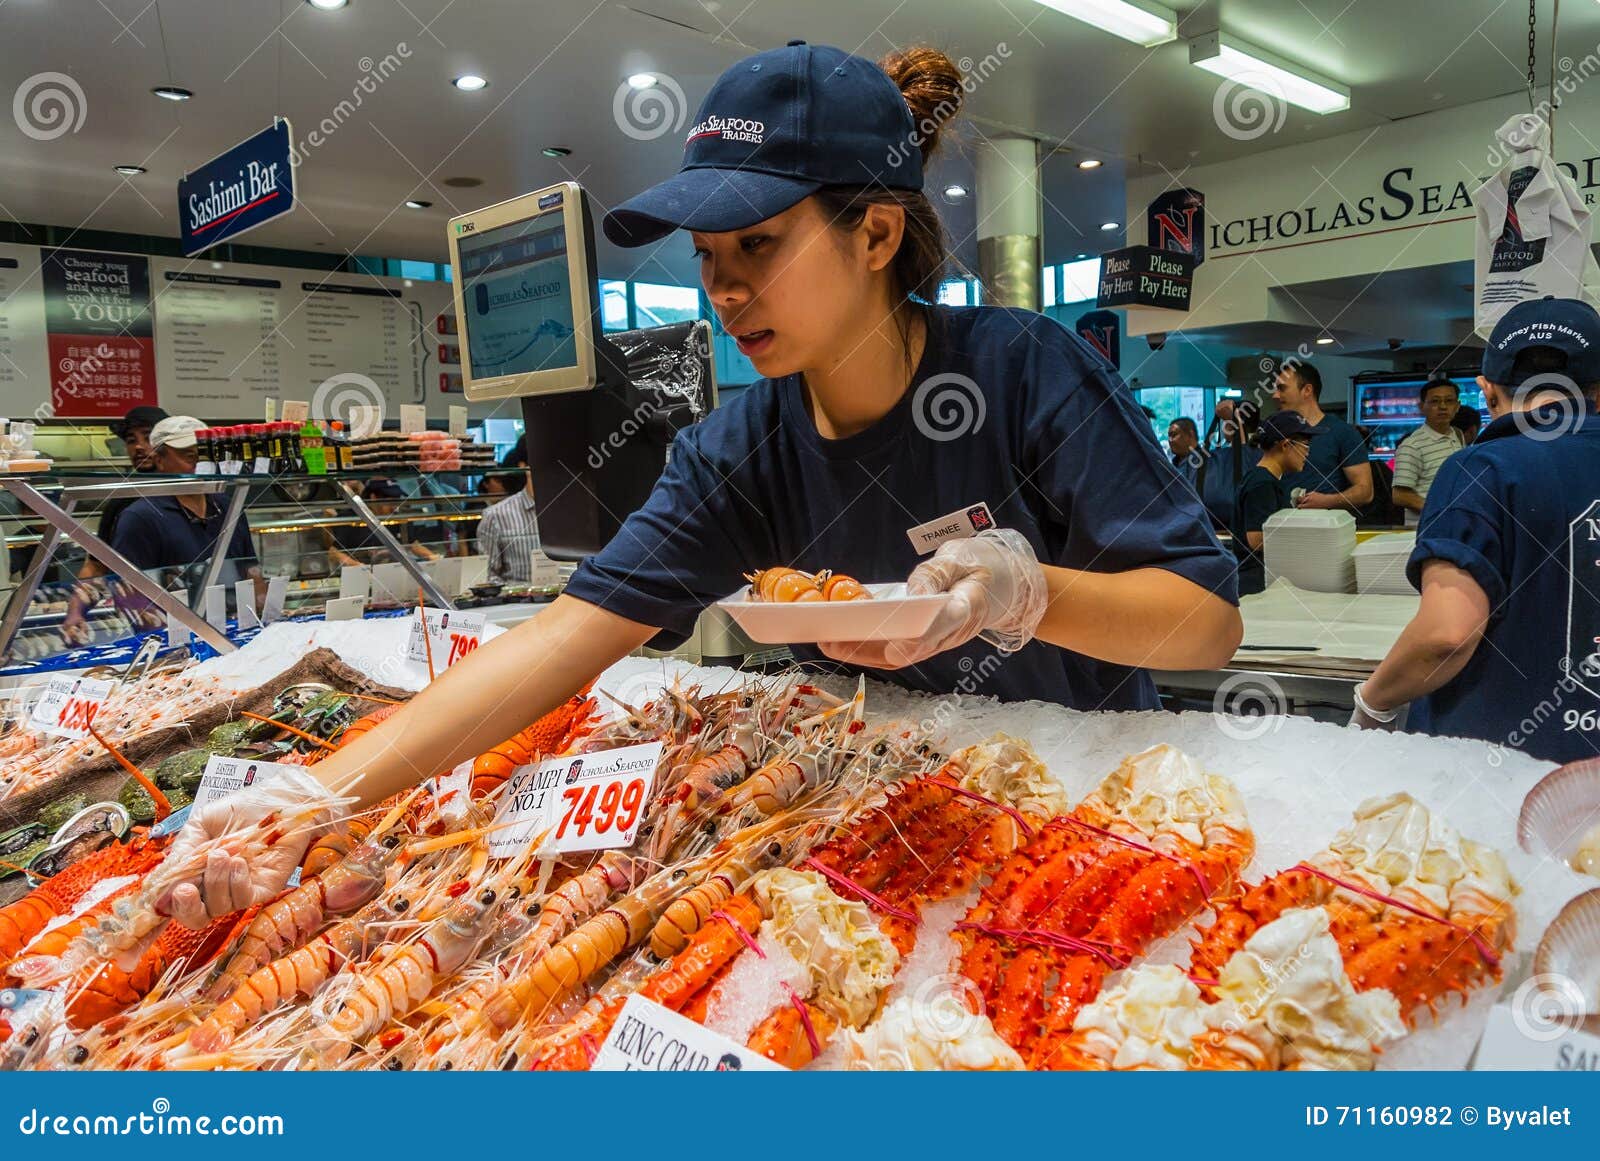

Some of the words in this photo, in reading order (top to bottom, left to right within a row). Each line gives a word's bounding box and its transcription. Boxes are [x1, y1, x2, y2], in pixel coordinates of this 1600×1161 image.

[722, 131, 764, 144] TRADERS
[189, 170, 247, 230] Sashimi
[247, 161, 278, 201] Bar
[64, 257, 103, 268] Choose
[105, 263, 128, 271] your
[1106, 257, 1130, 275] Please
[1149, 255, 1183, 276] Please
[64, 268, 129, 284] seafood
[66, 282, 88, 292] and
[110, 284, 130, 295] will
[1100, 280, 1112, 300] Pay
[1114, 278, 1134, 294] Here
[1140, 275, 1160, 299] Pay
[1161, 280, 1188, 298] Here
[66, 293, 98, 304] cook
[68, 303, 134, 323] YOU!
[1498, 326, 1530, 350] Sydney
[1531, 322, 1556, 330] Fish
[1557, 324, 1590, 348] Market
[1528, 332, 1553, 340] AUS
[921, 523, 961, 542] TRAINEE
[509, 767, 564, 796] SCAMPI
[509, 791, 546, 813] NO.1
[555, 777, 646, 840] 7499
[623, 831, 633, 843] kg
[614, 1015, 664, 1066] KING
